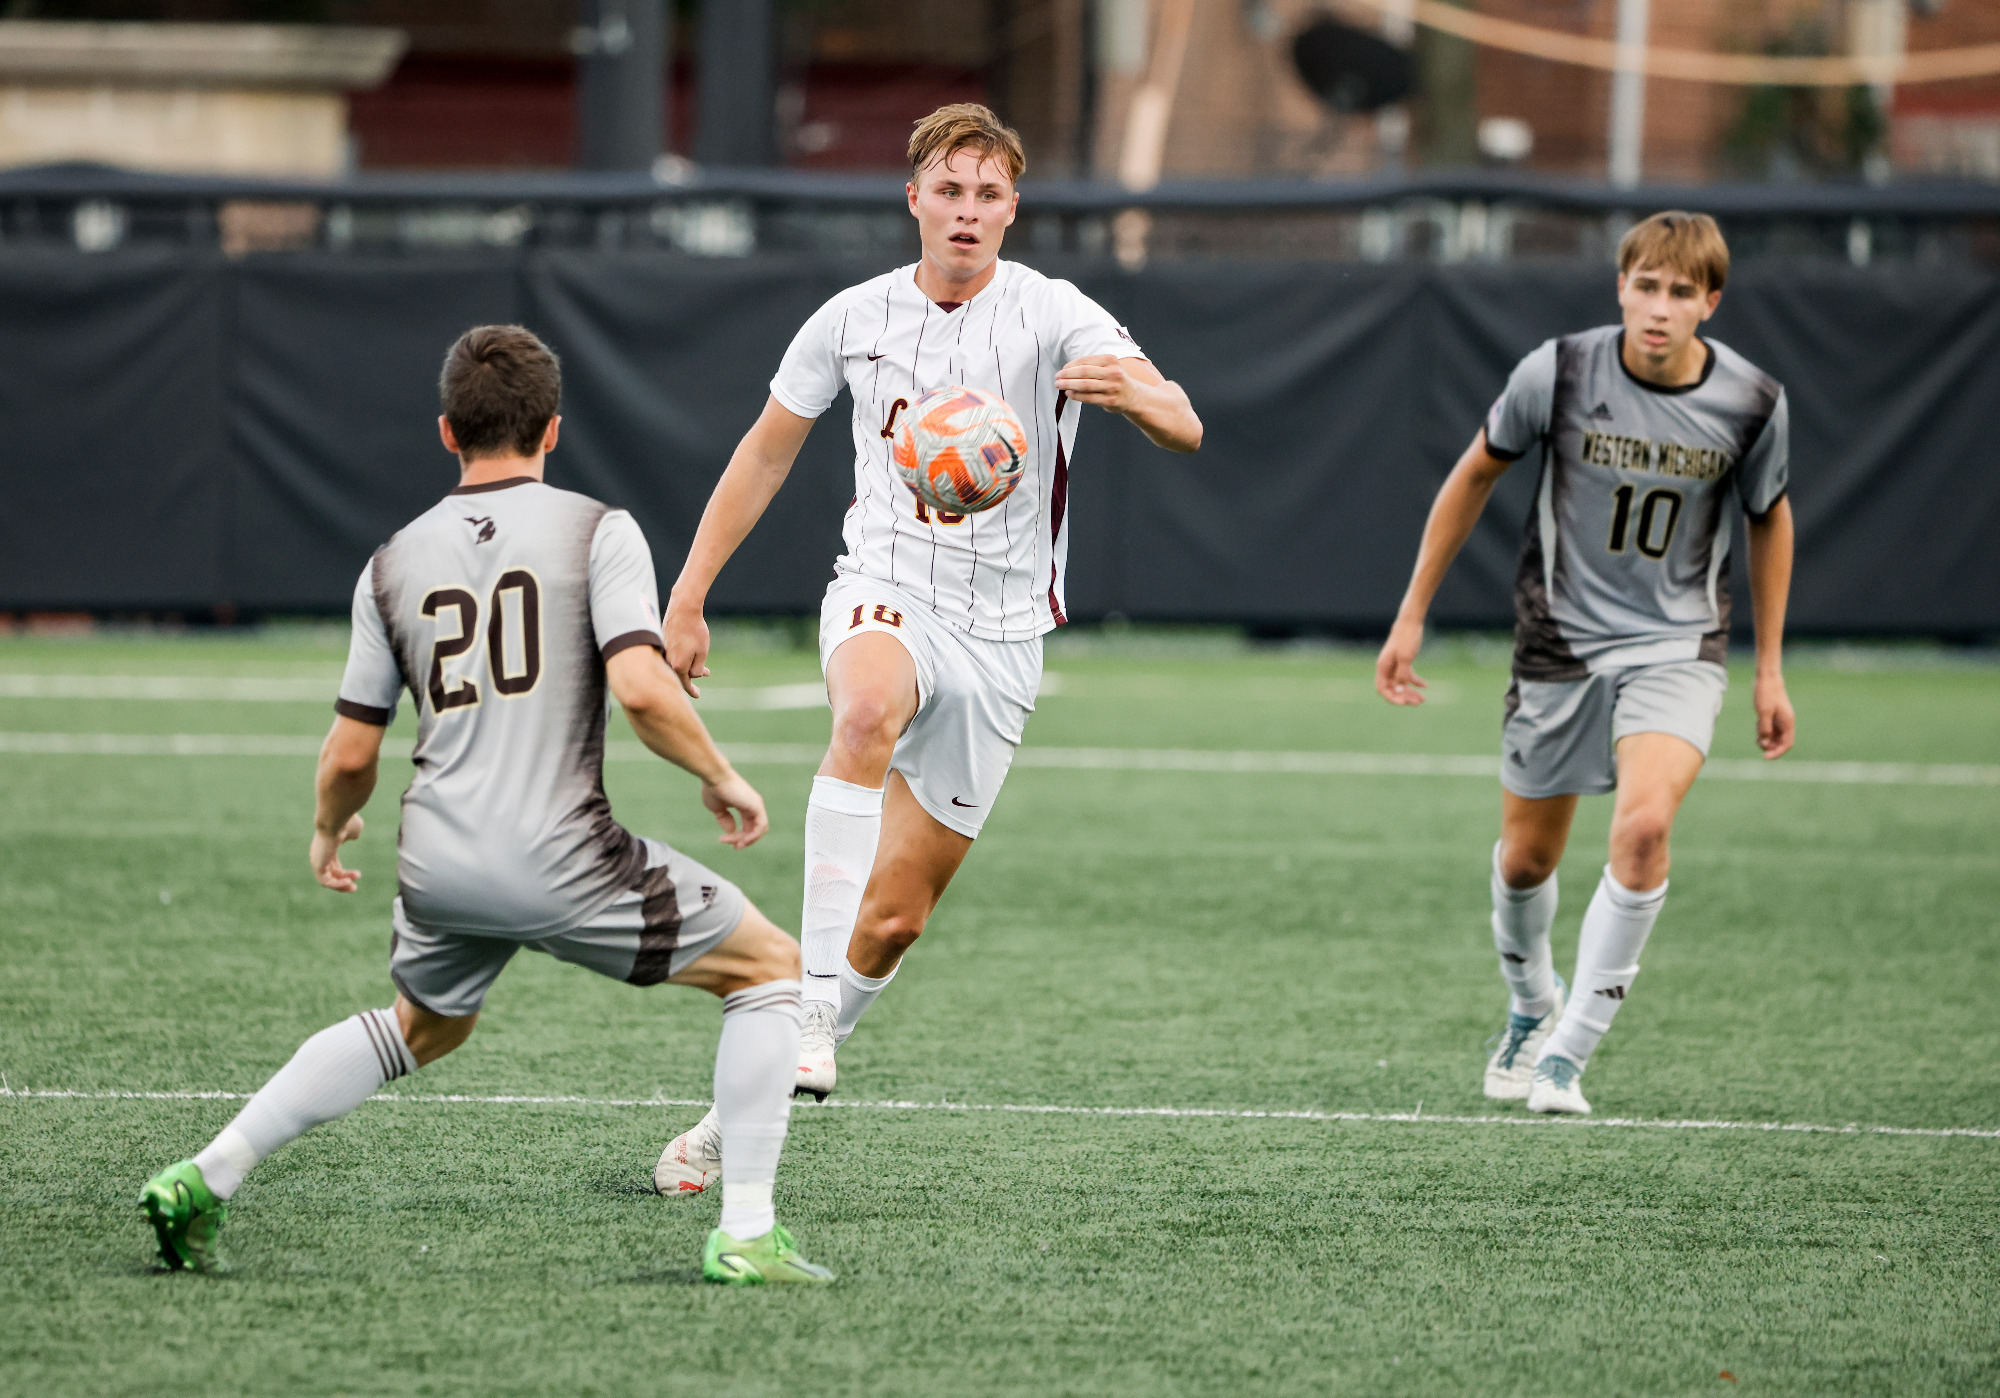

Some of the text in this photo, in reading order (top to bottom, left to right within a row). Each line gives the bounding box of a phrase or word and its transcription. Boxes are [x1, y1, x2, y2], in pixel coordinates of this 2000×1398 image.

[1582, 429, 1651, 472] WESTERN
[1606, 482, 1684, 561] 10
[418, 564, 545, 718] 20
